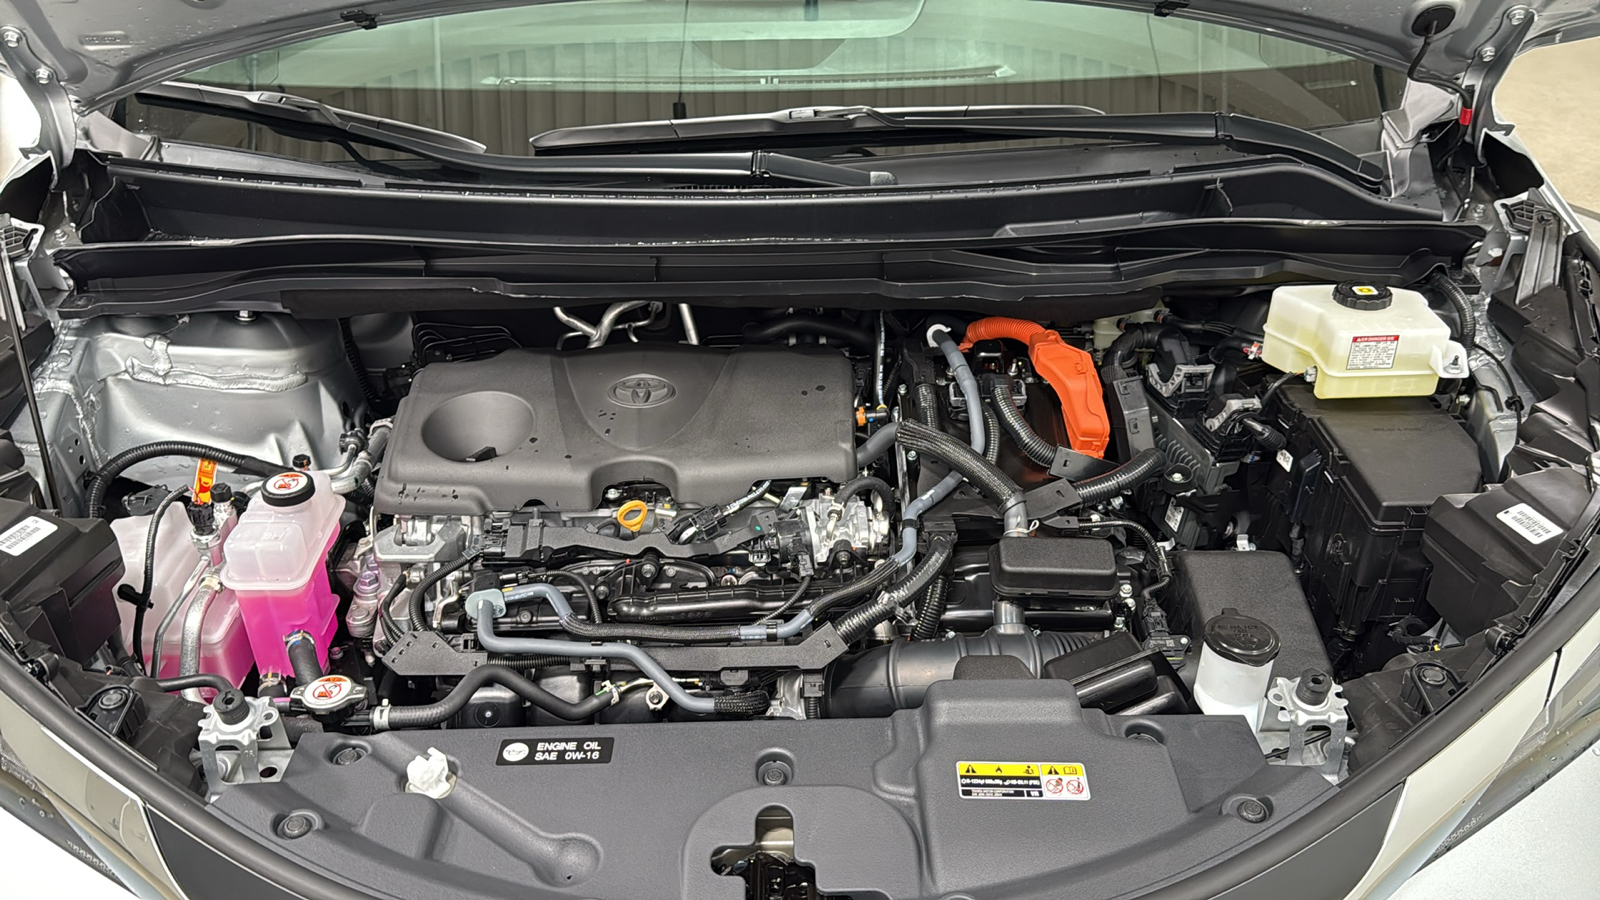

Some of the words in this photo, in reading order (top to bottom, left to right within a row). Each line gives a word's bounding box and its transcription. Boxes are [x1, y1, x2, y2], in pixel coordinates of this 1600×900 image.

[537, 742, 577, 751] ENGINE
[583, 741, 601, 750] OIL
[534, 752, 558, 761] SAE
[564, 751, 599, 760] 0W-16
